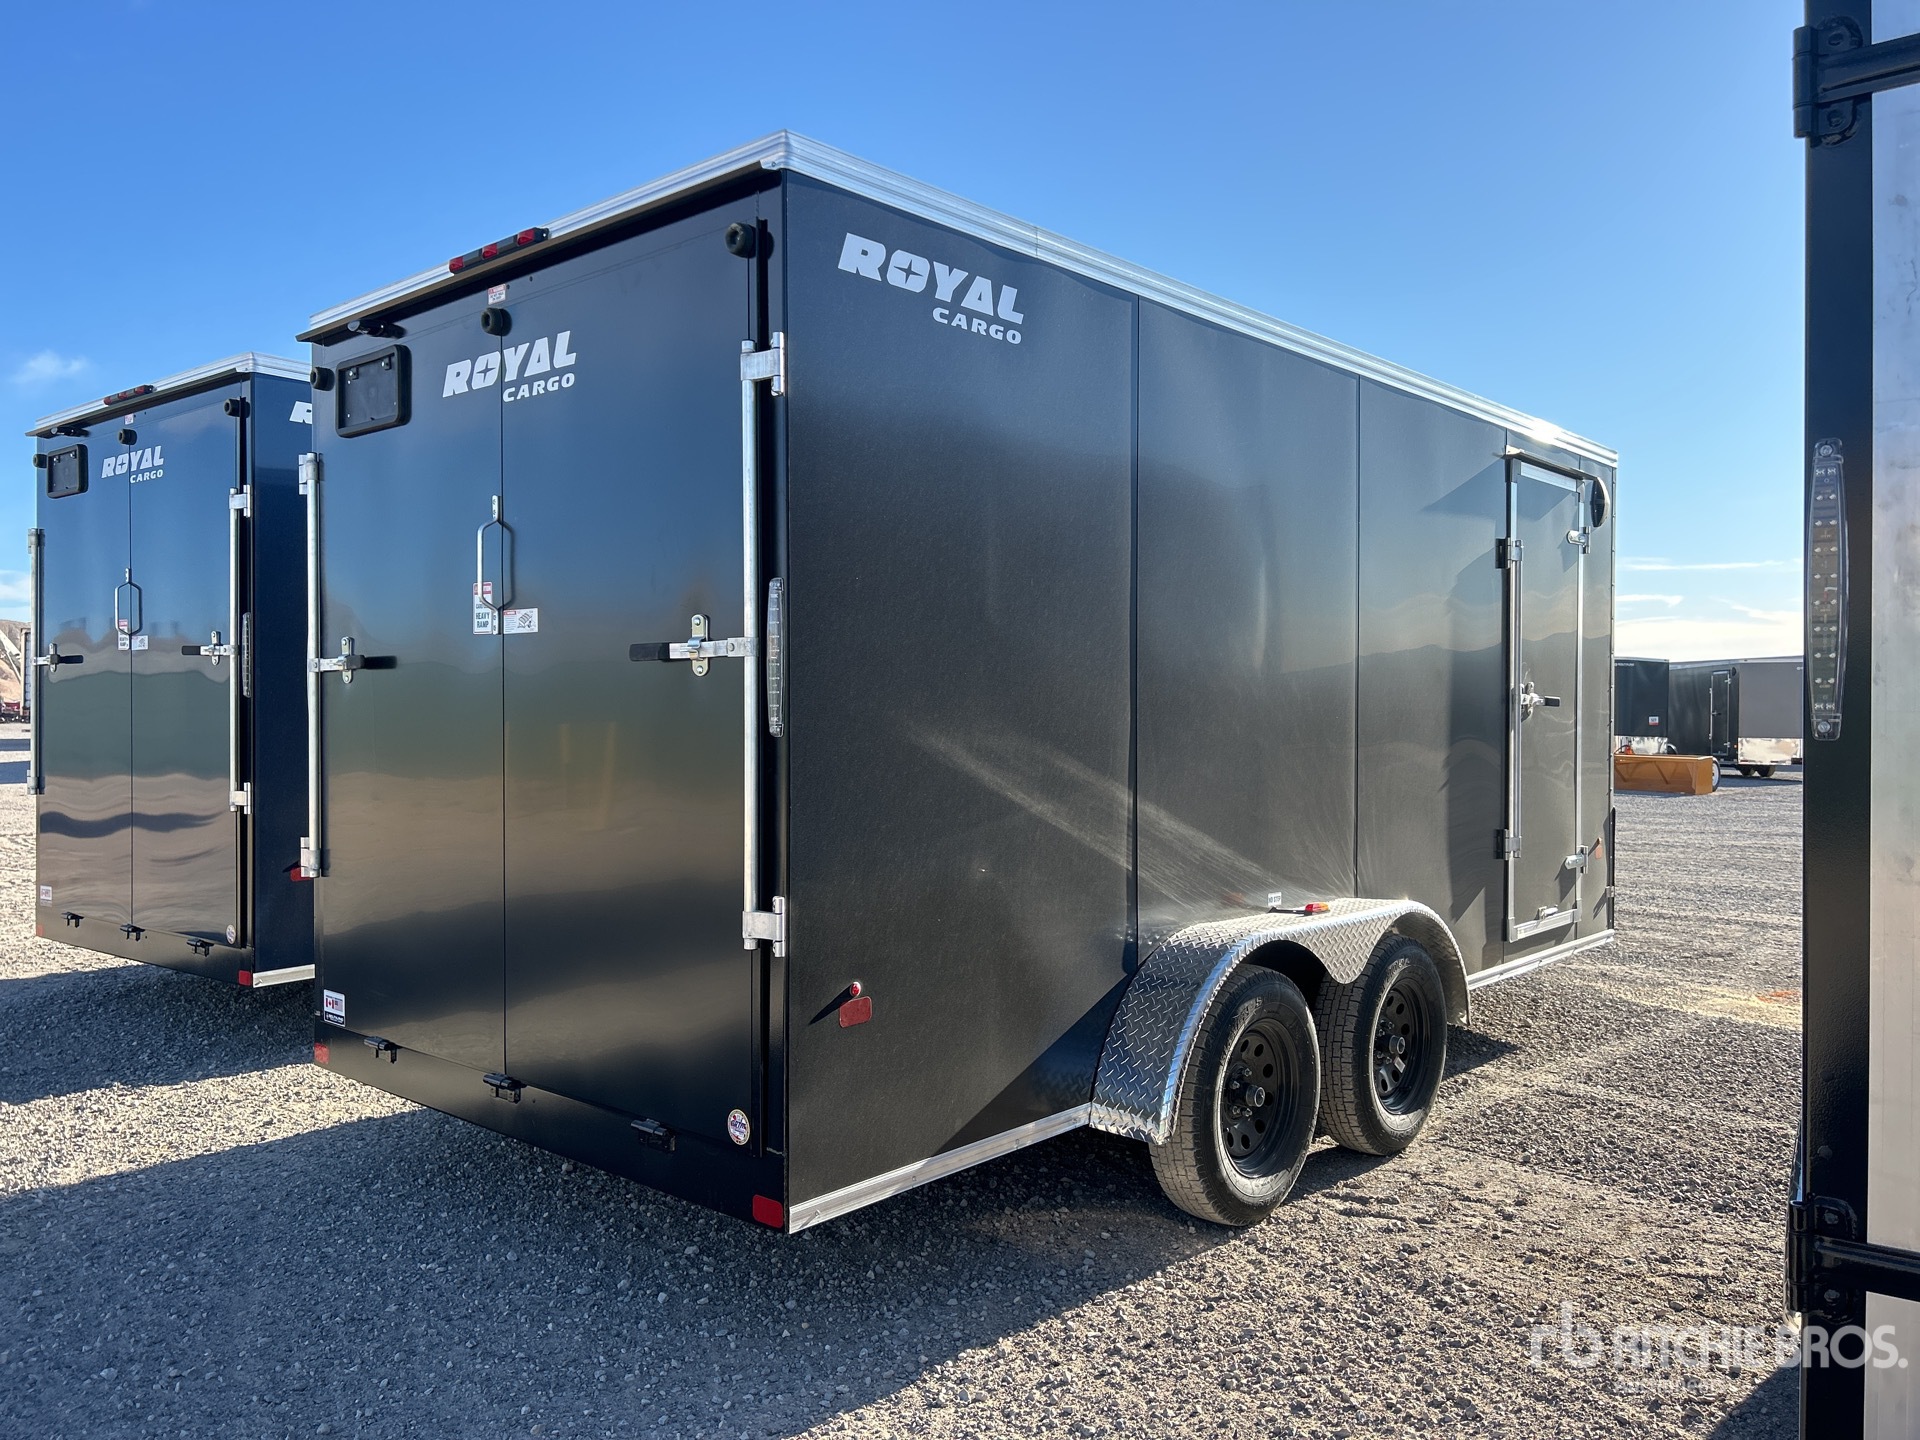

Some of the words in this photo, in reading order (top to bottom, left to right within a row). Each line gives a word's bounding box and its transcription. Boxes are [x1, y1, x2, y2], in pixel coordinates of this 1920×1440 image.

[837, 232, 1025, 325] ROYAL
[932, 307, 1022, 345] CARGO
[442, 330, 577, 398] ROYAL
[502, 372, 576, 403] CARGO
[101, 445, 165, 479] ROYAL
[129, 469, 164, 484] CARGO
[475, 612, 490, 620] HEAVY
[476, 620, 489, 628] RAMP
